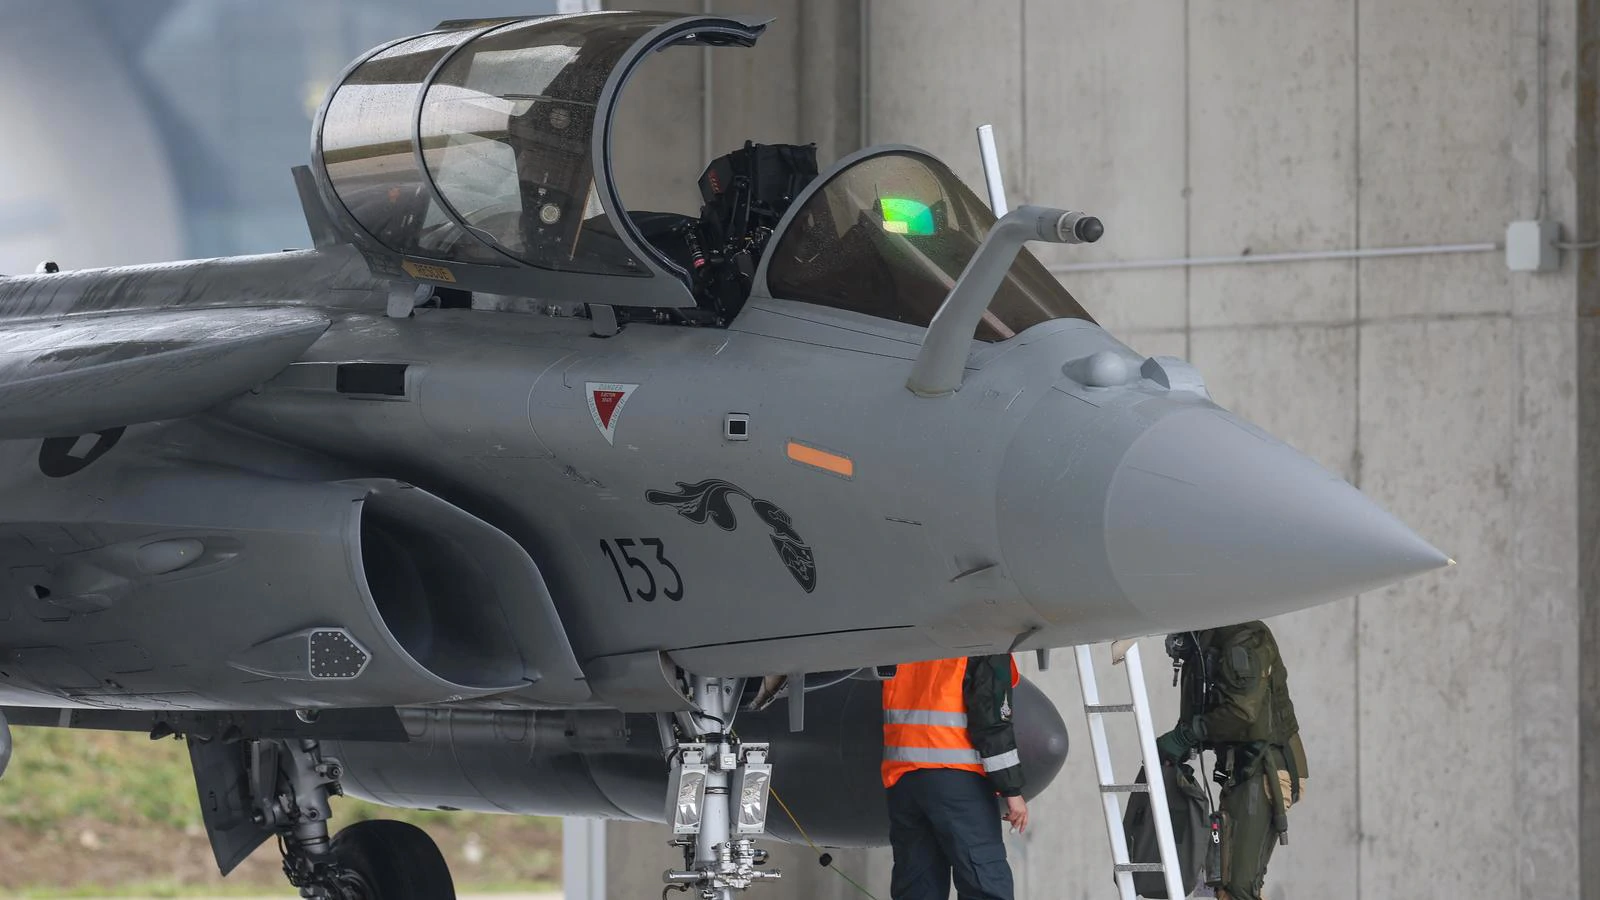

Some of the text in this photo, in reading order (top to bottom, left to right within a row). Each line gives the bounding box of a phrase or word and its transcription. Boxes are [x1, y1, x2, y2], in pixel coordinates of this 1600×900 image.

[414, 263, 449, 280] RESCUE
[597, 383, 625, 391] DANGER
[600, 537, 684, 602] 153
